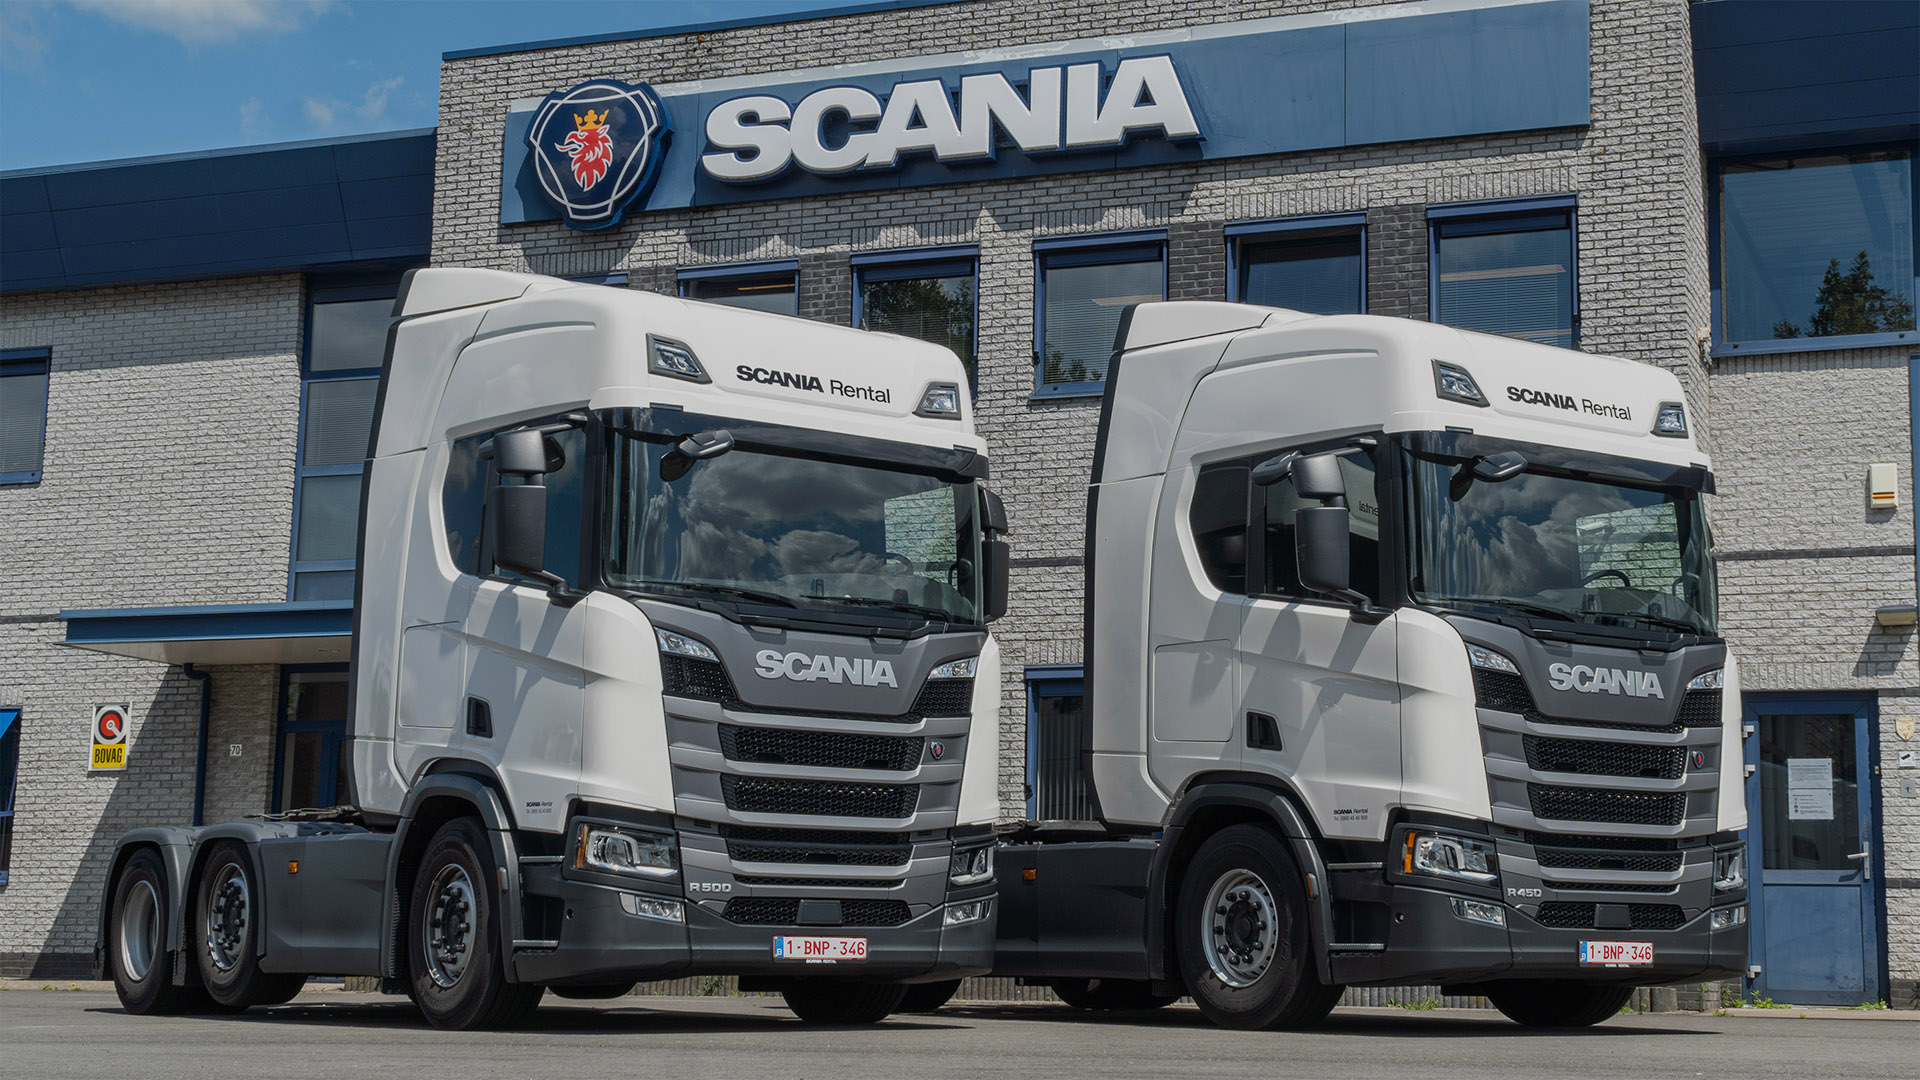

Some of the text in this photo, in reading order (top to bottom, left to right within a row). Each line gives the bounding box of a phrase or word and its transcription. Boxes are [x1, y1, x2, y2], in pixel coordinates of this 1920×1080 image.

[702, 54, 1200, 181] SCANIA
[736, 365, 891, 404] SCANIA Rental
[1506, 386, 1632, 421] SCANIA Rental
[754, 649, 898, 689] SCANIA
[1548, 662, 1664, 700] SCANIA
[94, 748, 122, 763] BOVAG
[231, 745, 241, 755] 70
